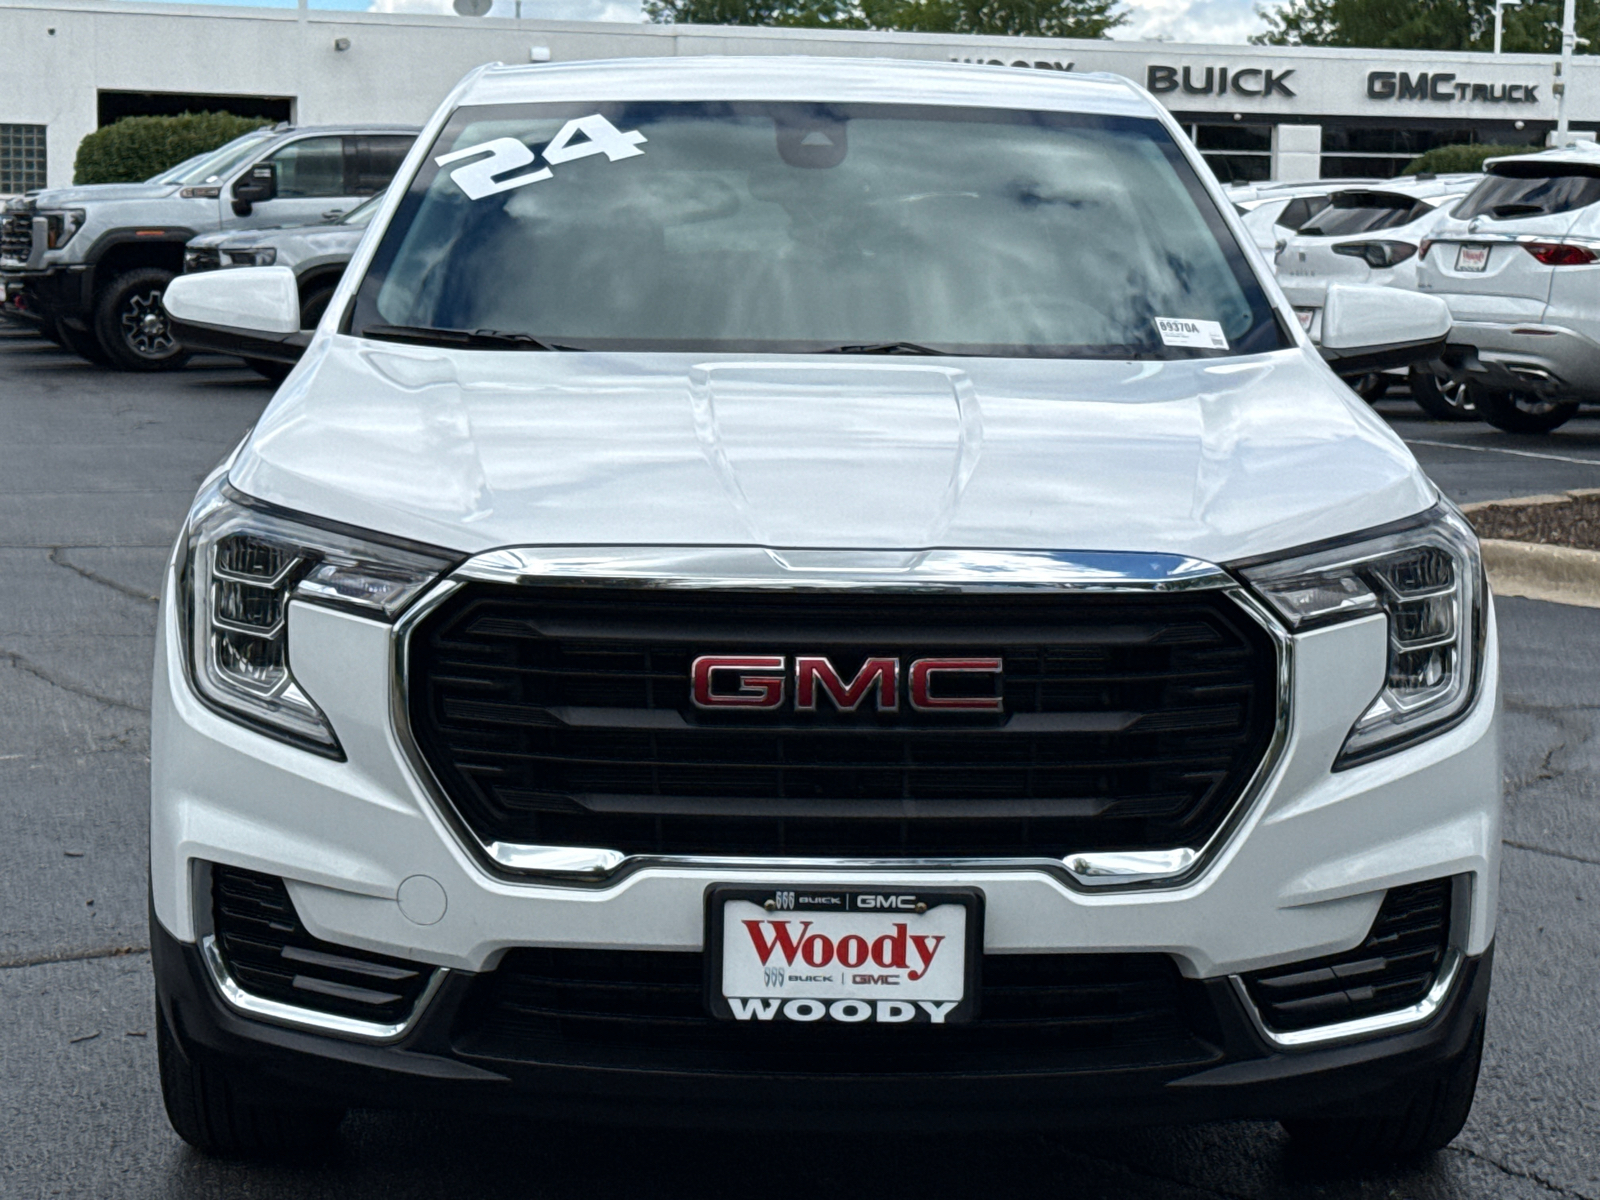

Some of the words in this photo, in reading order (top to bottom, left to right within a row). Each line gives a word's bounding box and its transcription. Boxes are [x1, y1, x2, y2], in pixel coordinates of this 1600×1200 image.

[1147, 65, 1297, 98] BUICK
[434, 113, 649, 201] 24
[691, 655, 1004, 713] GMC
[856, 894, 917, 909] GMC
[741, 919, 946, 981] Woody
[851, 974, 901, 985] GMC
[727, 998, 959, 1023] WOODY
